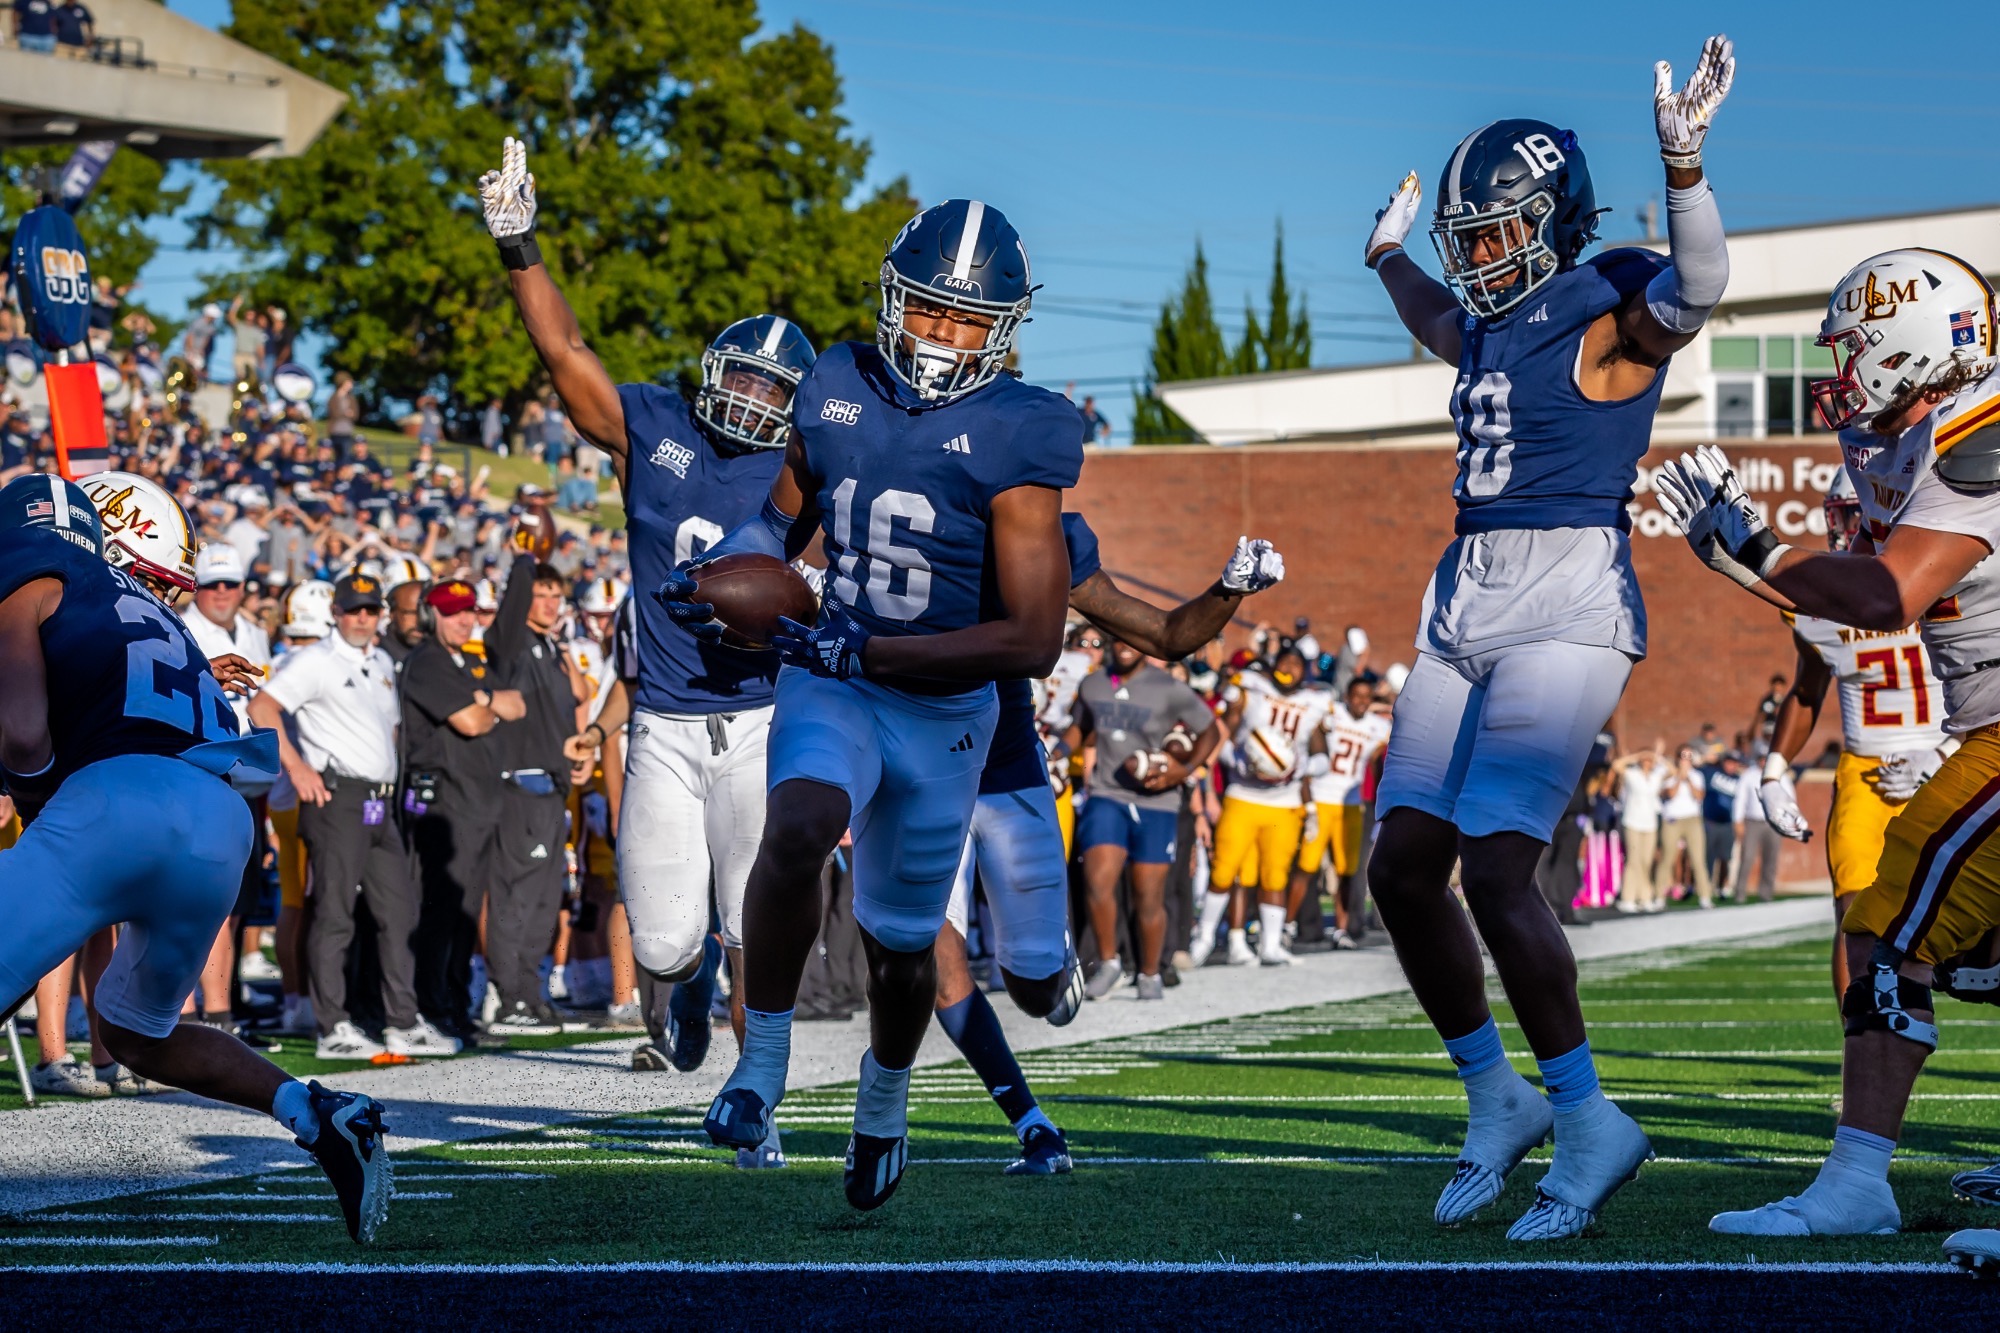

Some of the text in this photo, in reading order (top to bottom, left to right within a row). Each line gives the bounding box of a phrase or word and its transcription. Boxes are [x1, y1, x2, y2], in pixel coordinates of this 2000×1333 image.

[1513, 133, 1566, 180] 18
[1443, 205, 1464, 217] GATA
[944, 276, 973, 293] GATA
[1845, 270, 1919, 323] ULM
[755, 348, 778, 362] GATA
[821, 399, 862, 425] SBC
[656, 437, 695, 468] SBC
[68, 504, 93, 527] SBC
[89, 483, 158, 540] ULM
[1741, 514, 1761, 530] adidas
[50, 528, 97, 555] OUTHERN
[832, 477, 937, 622] 16
[829, 636, 846, 673] adidas
[1856, 643, 1931, 728] 21
[1271, 707, 1301, 740] 14
[1332, 738, 1364, 777] 21
